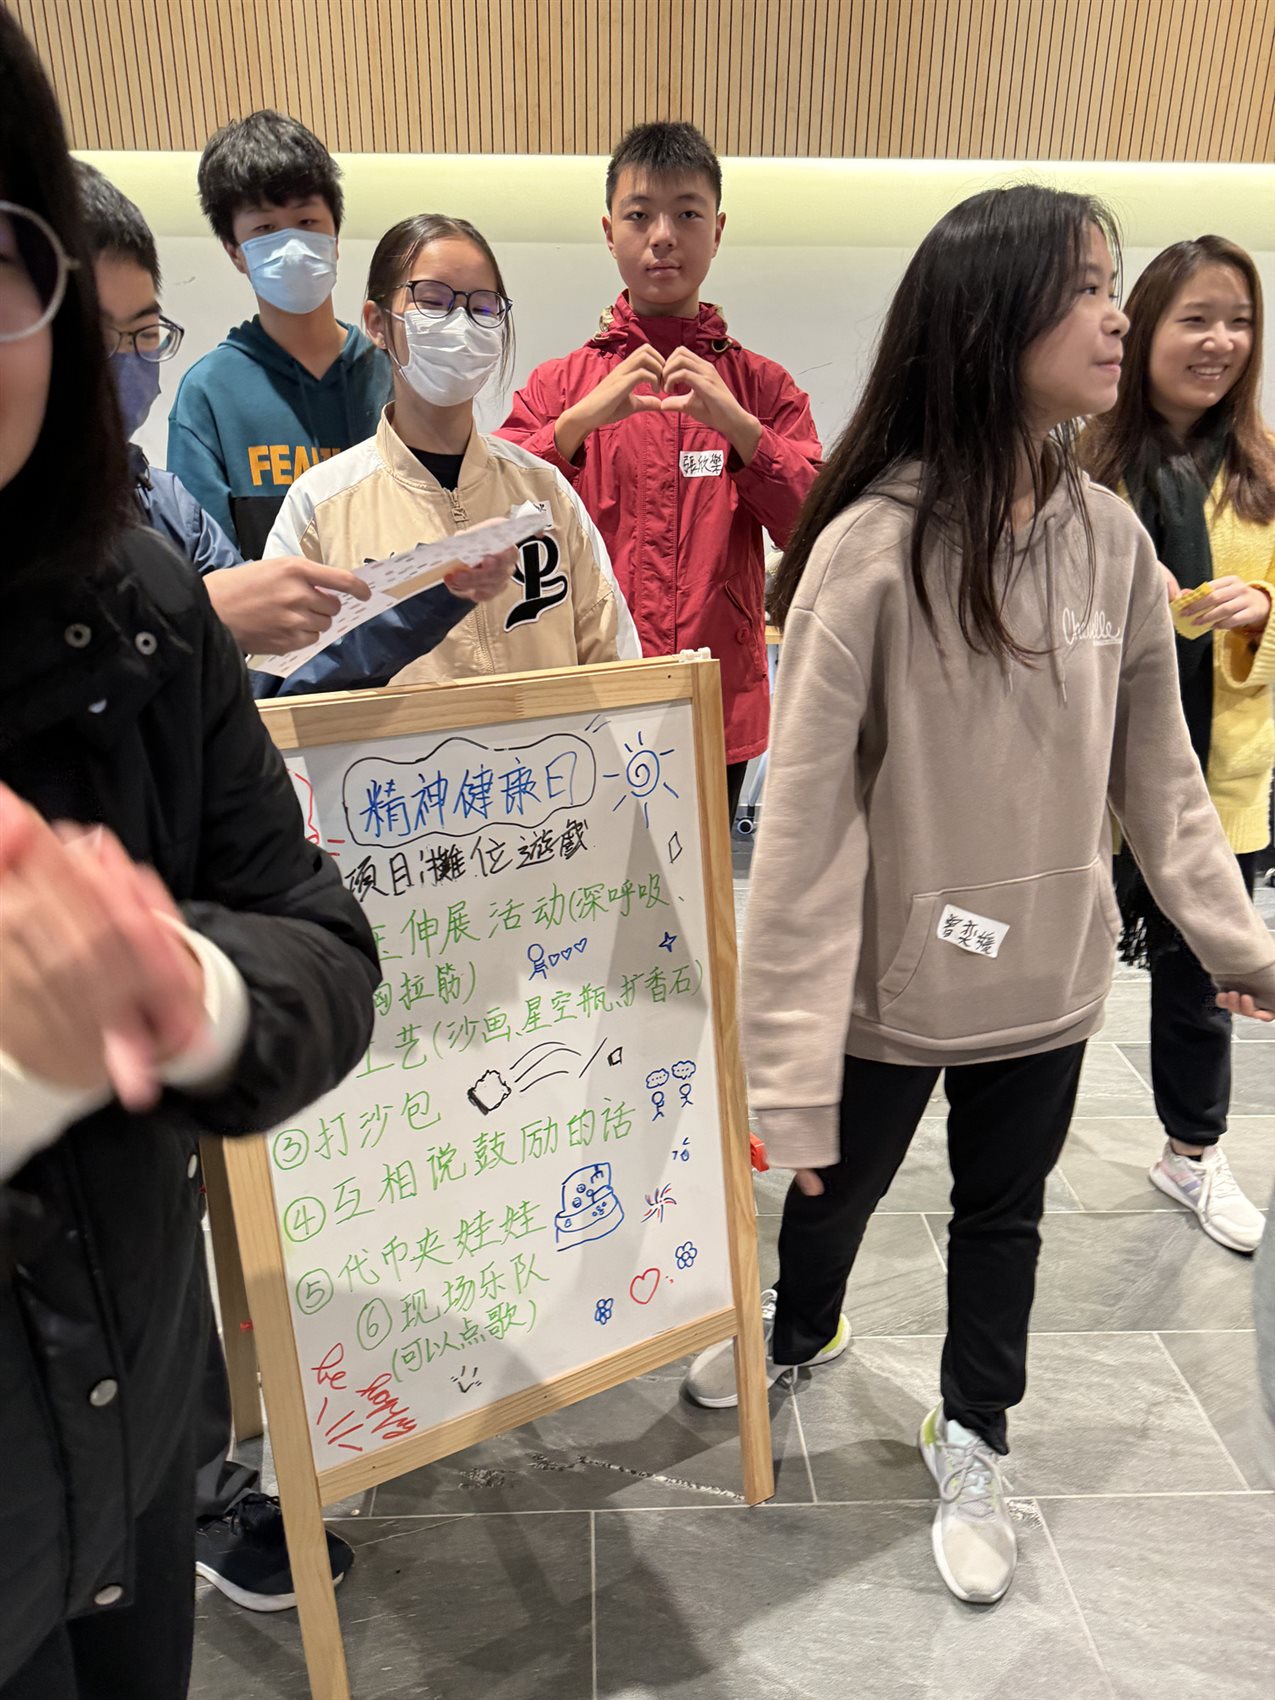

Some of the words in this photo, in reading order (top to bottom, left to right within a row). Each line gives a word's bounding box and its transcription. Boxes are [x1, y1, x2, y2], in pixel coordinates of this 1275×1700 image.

[359, 751, 577, 837] 精神健康日
